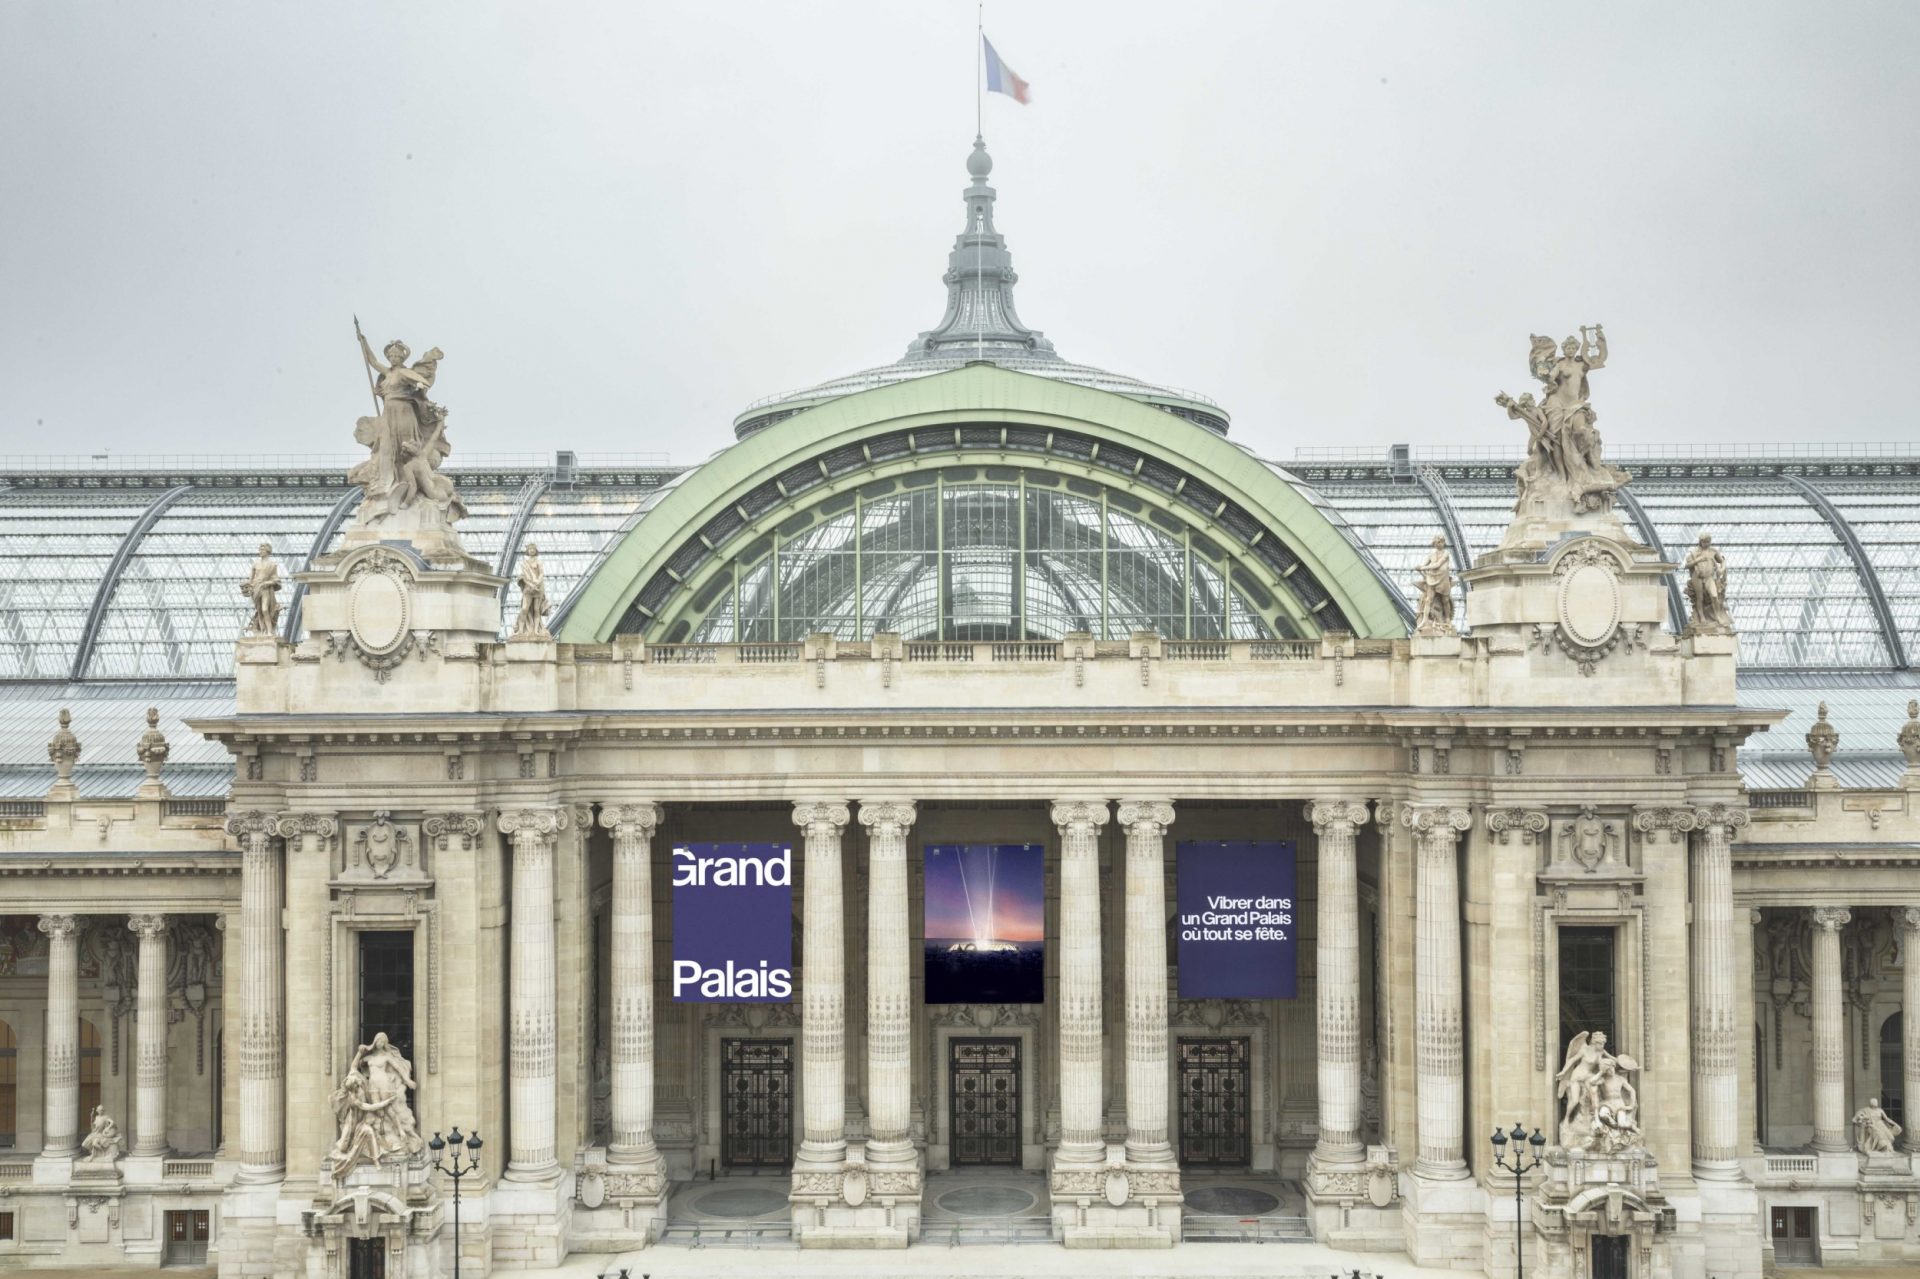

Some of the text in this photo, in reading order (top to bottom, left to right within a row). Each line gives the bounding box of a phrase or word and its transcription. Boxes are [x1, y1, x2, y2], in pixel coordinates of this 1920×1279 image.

[673, 848, 791, 886] Grand
[1207, 896, 1291, 909] Vibrer dans
[1181, 911, 1292, 925] un Grand Palais
[1182, 926, 1287, 941] où tout se fête.
[673, 960, 792, 998] Palais
